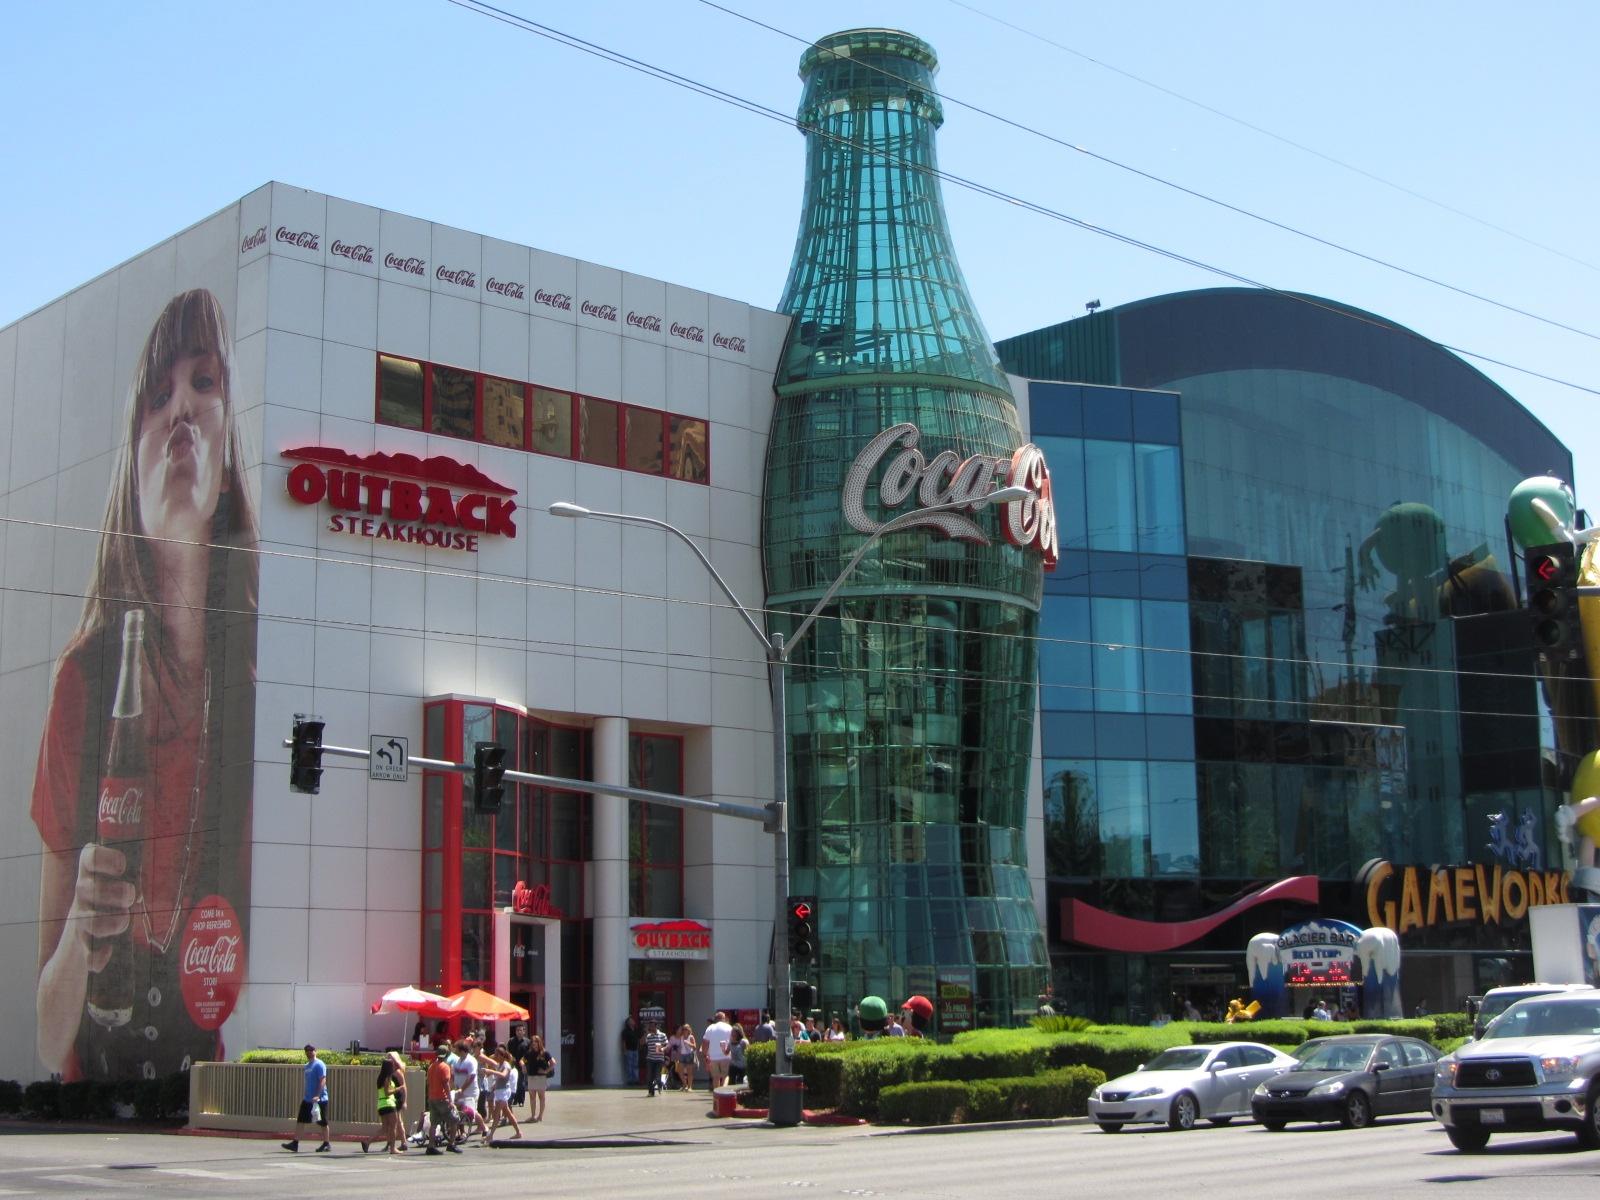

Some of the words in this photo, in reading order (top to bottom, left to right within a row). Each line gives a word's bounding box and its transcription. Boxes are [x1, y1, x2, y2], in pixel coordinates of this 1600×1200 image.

[275, 226, 320, 251] Coca-Cola
[330, 240, 374, 264] Coca-Cola
[384, 253, 426, 276] Coca-Cola
[436, 265, 476, 289] Coca-Cola
[485, 277, 525, 300] Coca-Cola
[534, 288, 572, 312] Coca-Cola
[580, 300, 618, 322] Coca-Cola
[626, 311, 662, 333] Coca-Cola
[669, 322, 705, 343] Coca-Cola
[712, 332, 747, 354] Coca-Cola
[286, 463, 518, 538] OUTBACK
[329, 514, 479, 552] STEAKHOUSE
[635, 932, 711, 949] OUTBACK
[1277, 932, 1327, 948] GLACIER
[1329, 932, 1355, 946] BAR
[184, 936, 240, 975] Coca-Cola
